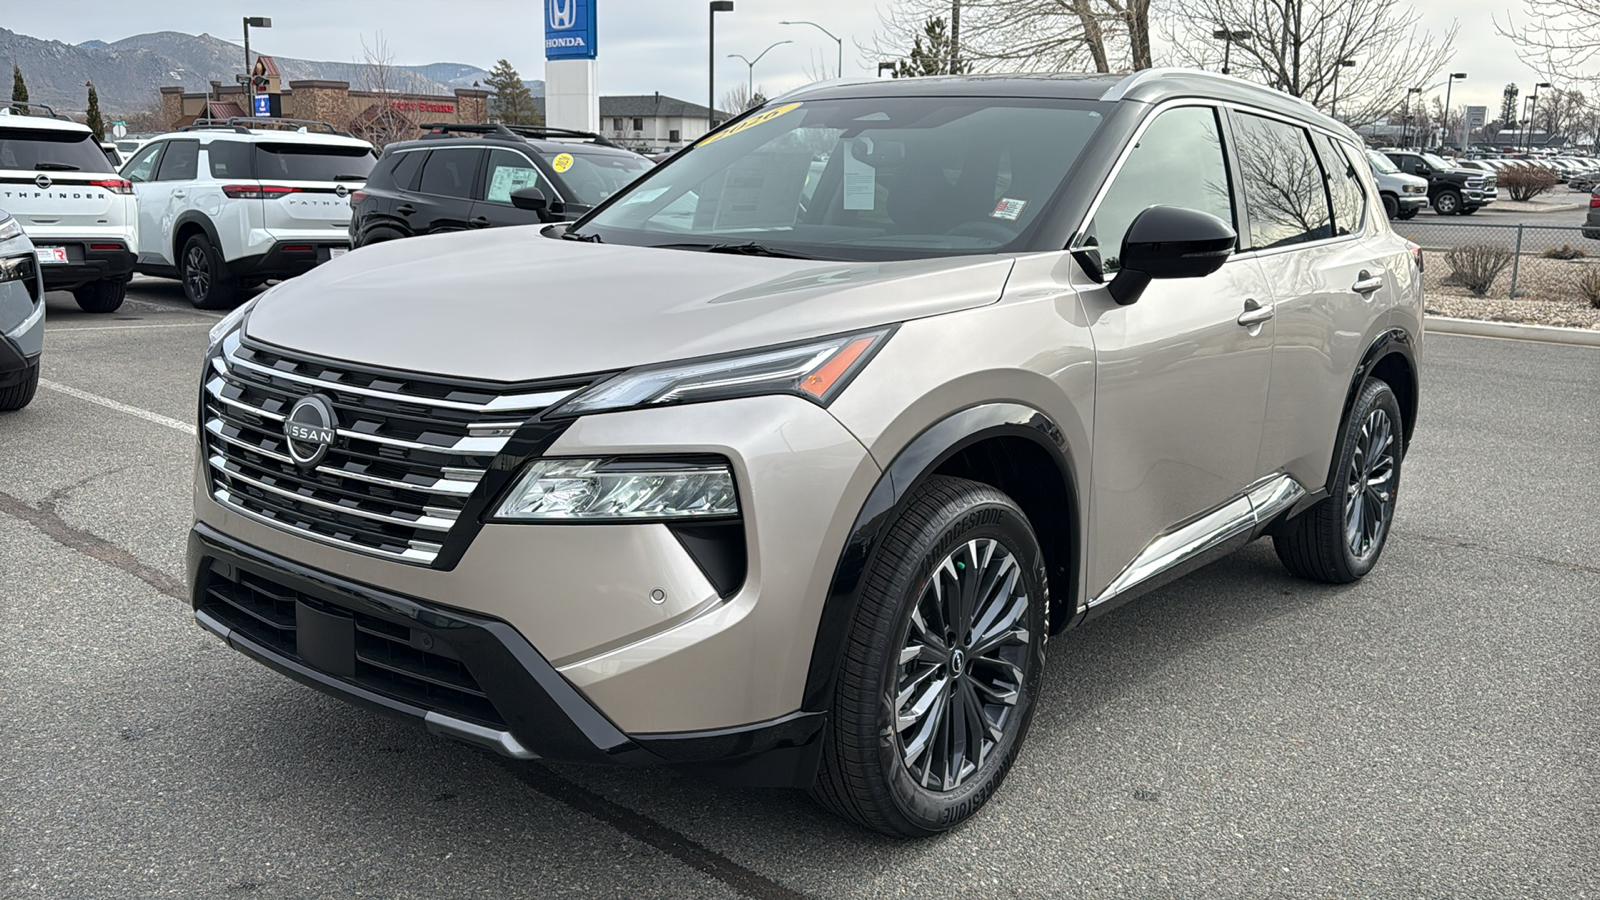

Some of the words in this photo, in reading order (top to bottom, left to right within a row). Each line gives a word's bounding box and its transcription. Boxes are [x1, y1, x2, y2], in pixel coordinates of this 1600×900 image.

[546, 37, 585, 48] HONDA
[284, 422, 332, 443] NISSAN
[922, 508, 1005, 573] BRIDGESTONE
